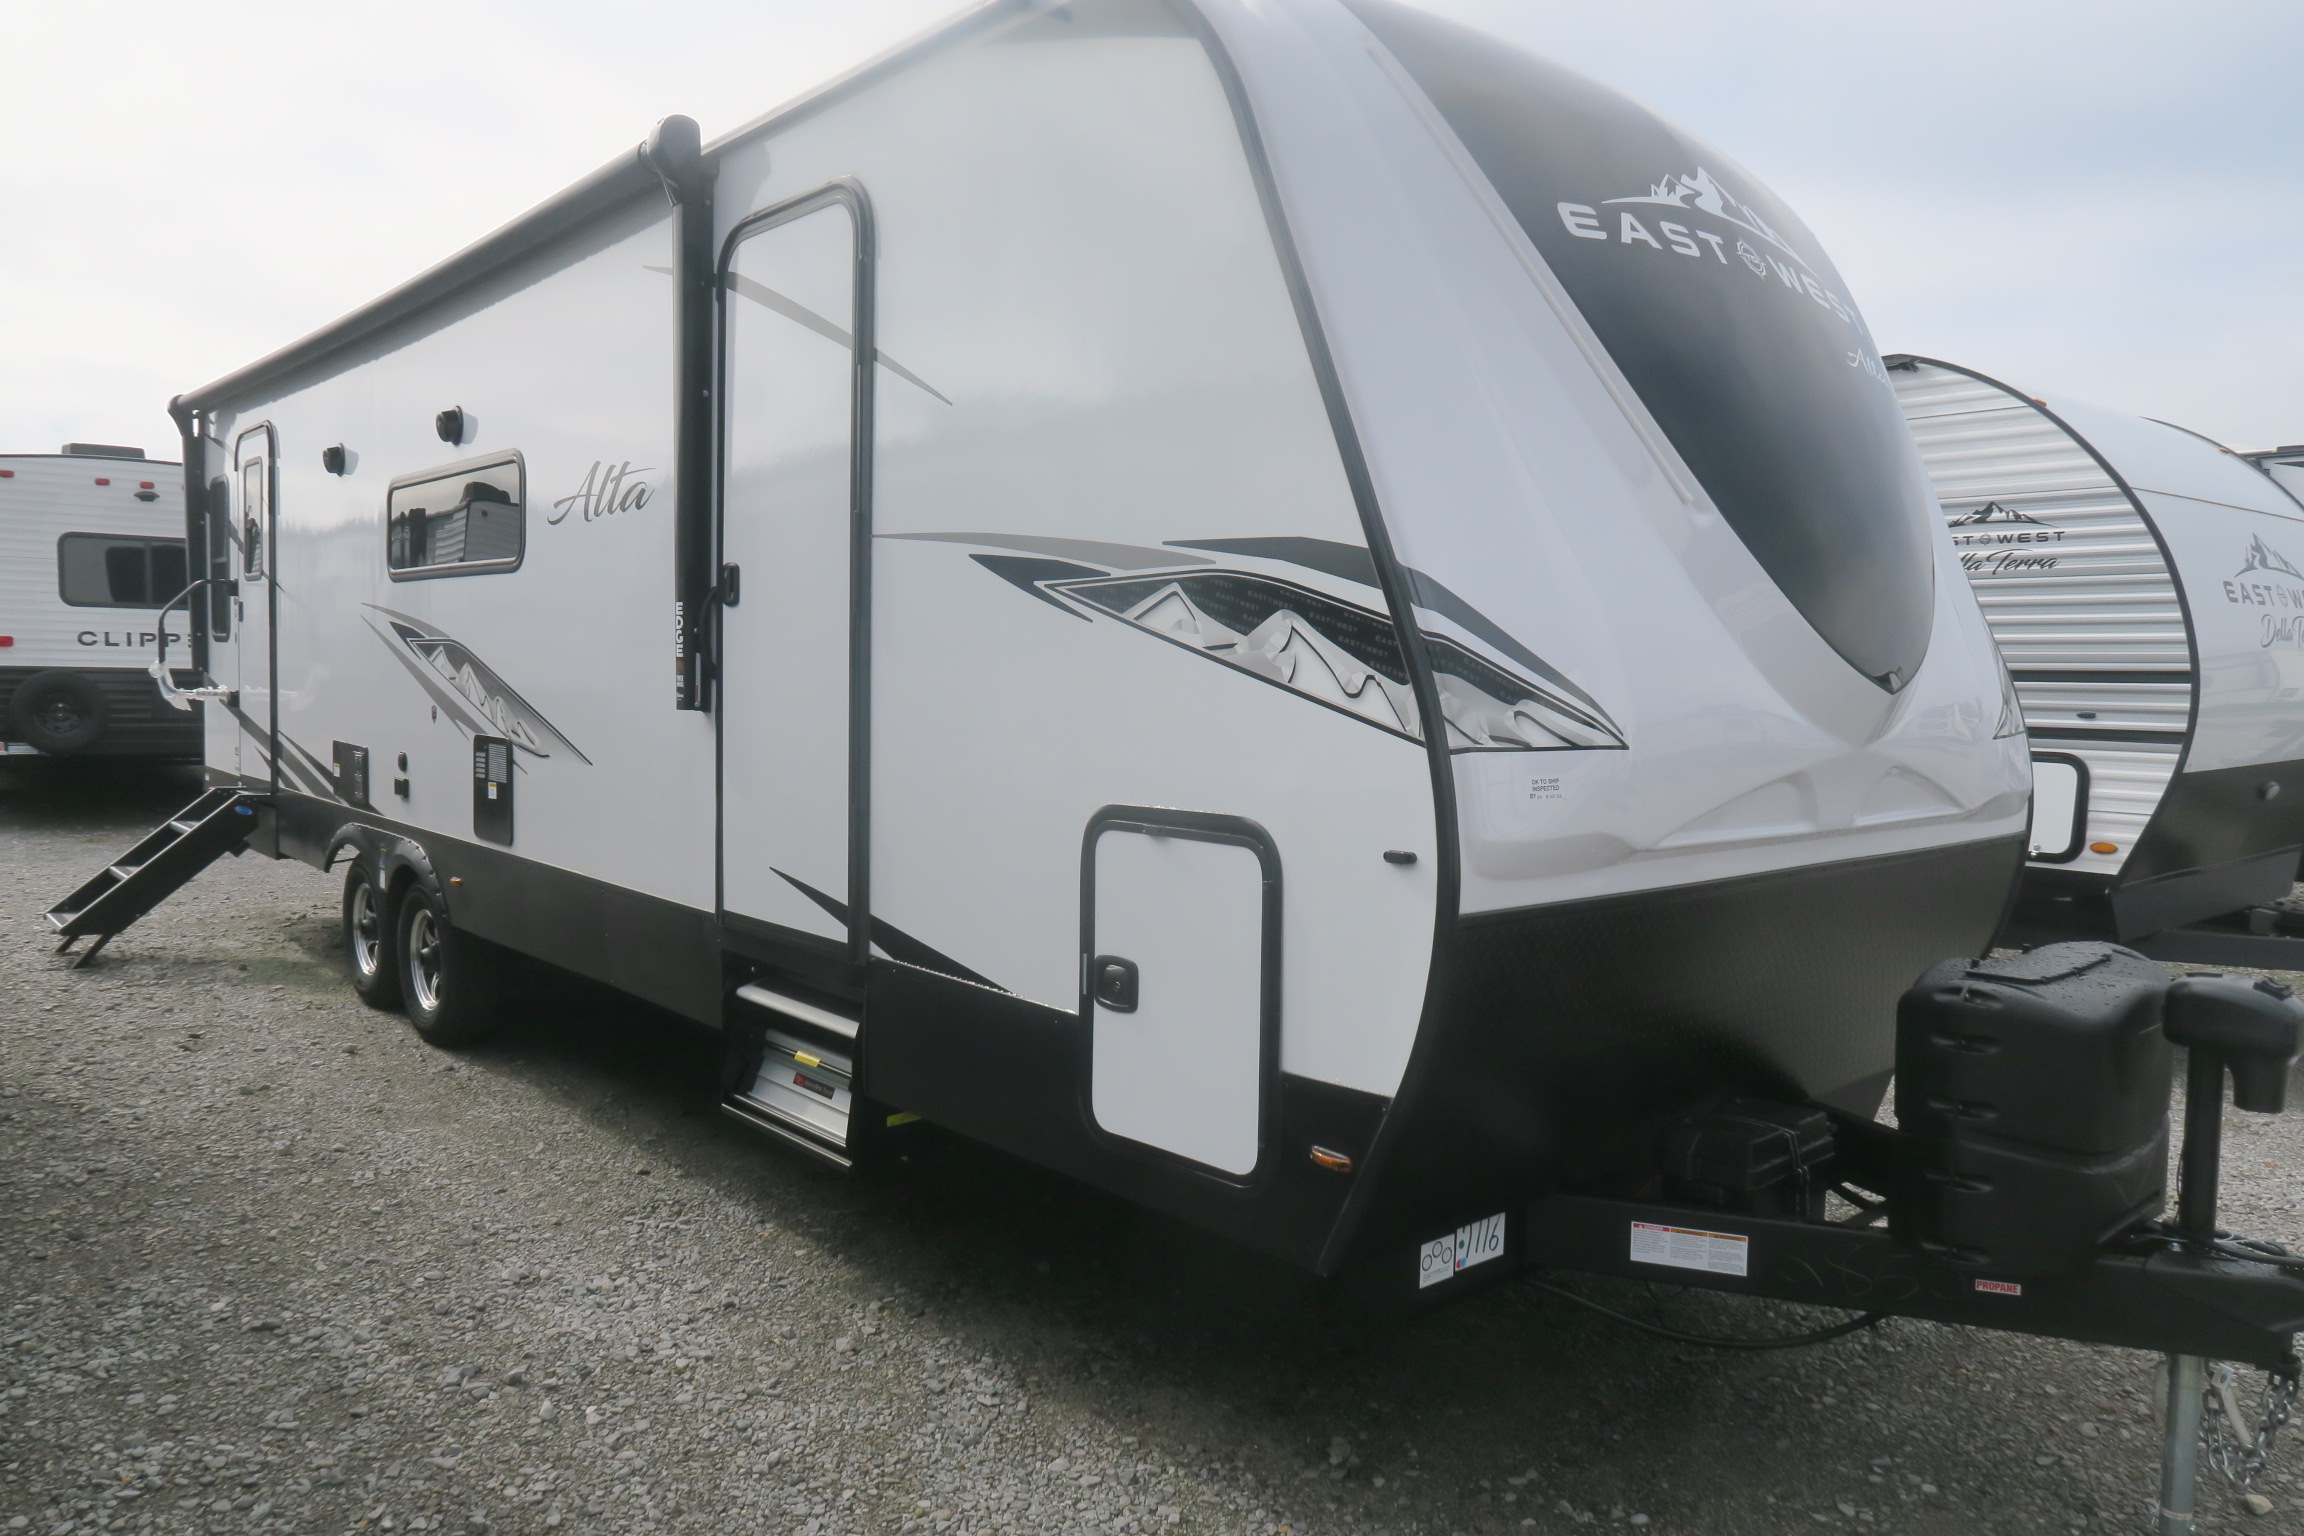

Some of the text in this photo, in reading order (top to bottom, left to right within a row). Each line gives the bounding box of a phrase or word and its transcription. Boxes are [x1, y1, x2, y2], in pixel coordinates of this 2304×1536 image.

[1556, 201, 1728, 265] EAST
[1765, 254, 1863, 335] WEST
[547, 460, 656, 526] Alta
[1997, 531, 2065, 544] WEST
[1986, 548, 2061, 575] Terra
[2222, 580, 2275, 607] EAST
[676, 602, 684, 658] EDGE
[2261, 613, 2293, 648] Della
[1976, 1280, 2019, 1294] PROPANE
